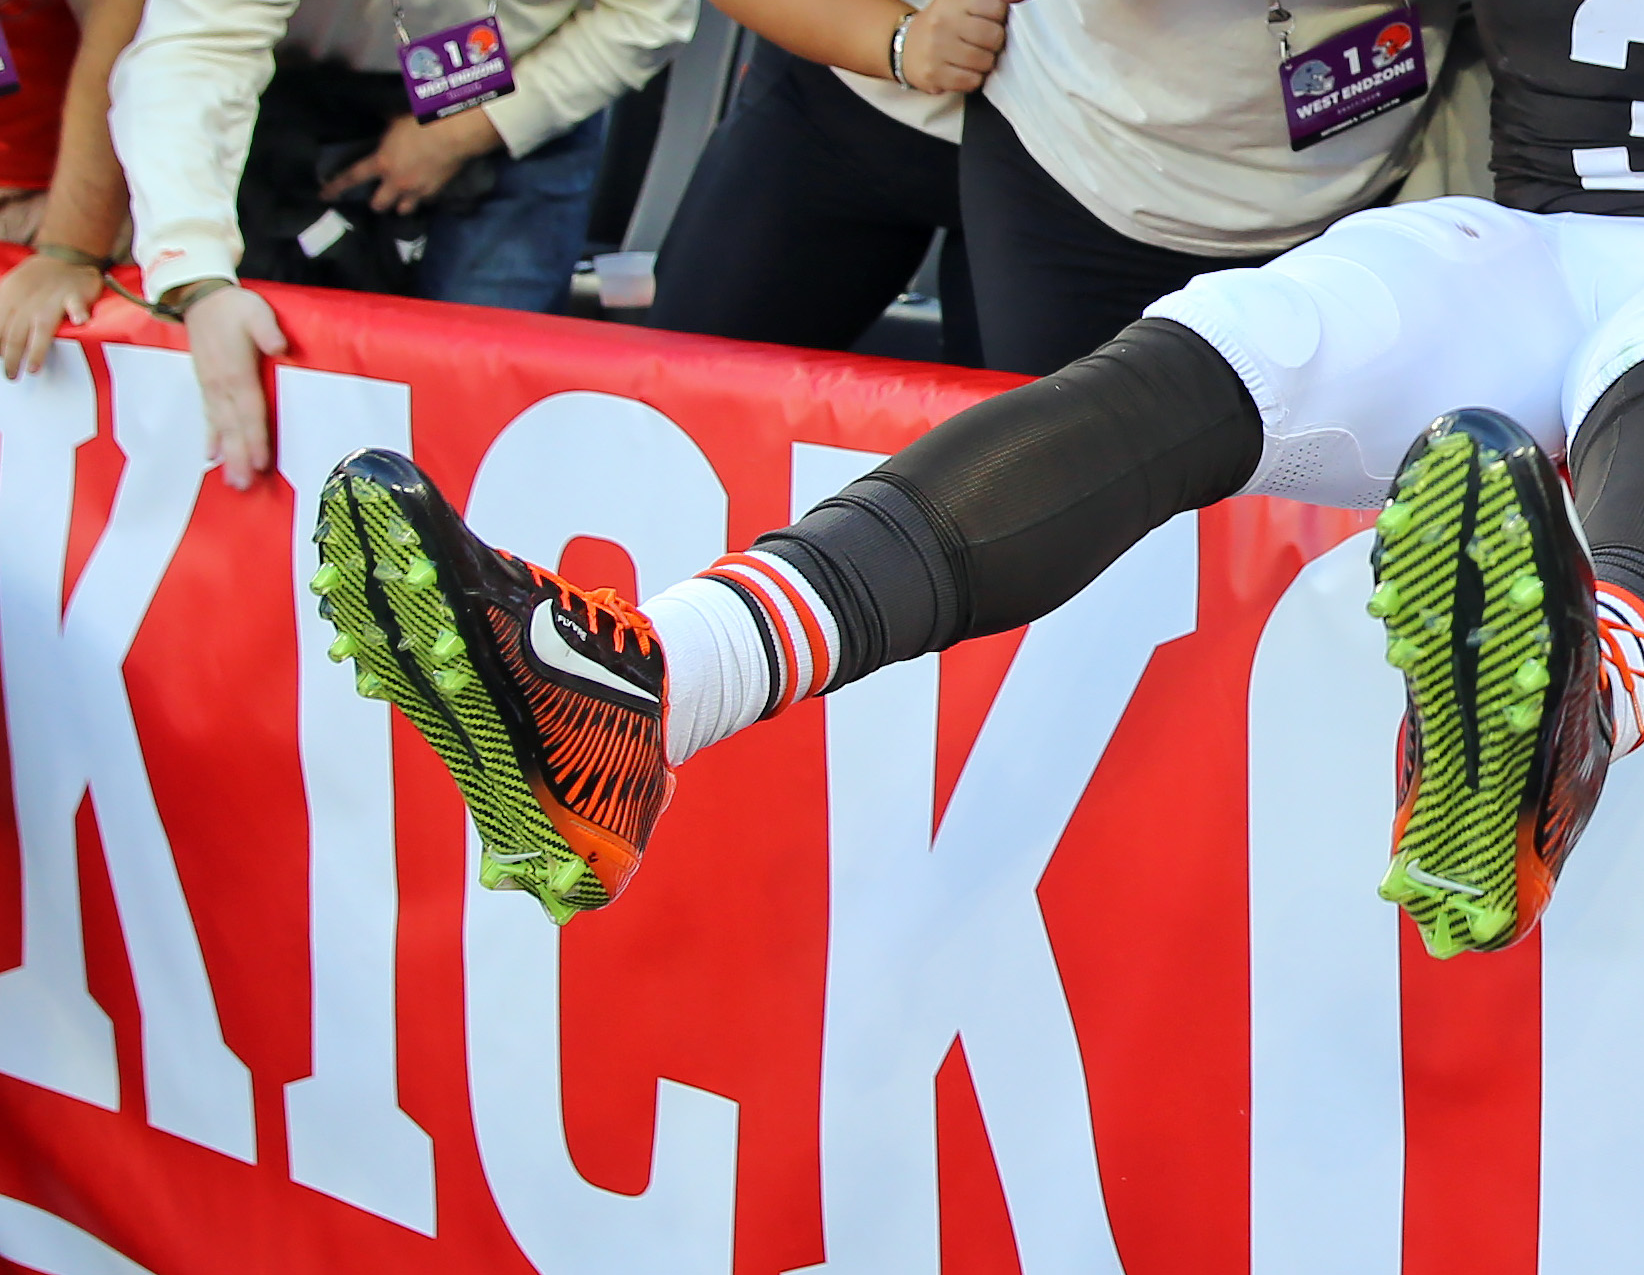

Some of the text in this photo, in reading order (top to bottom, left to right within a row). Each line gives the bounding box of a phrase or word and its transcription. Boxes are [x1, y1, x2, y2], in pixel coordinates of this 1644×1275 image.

[443, 40, 464, 68] 1
[1343, 46, 1361, 75] 1
[1296, 91, 1340, 119] WEST
[1342, 57, 1416, 100] ENDZONE
